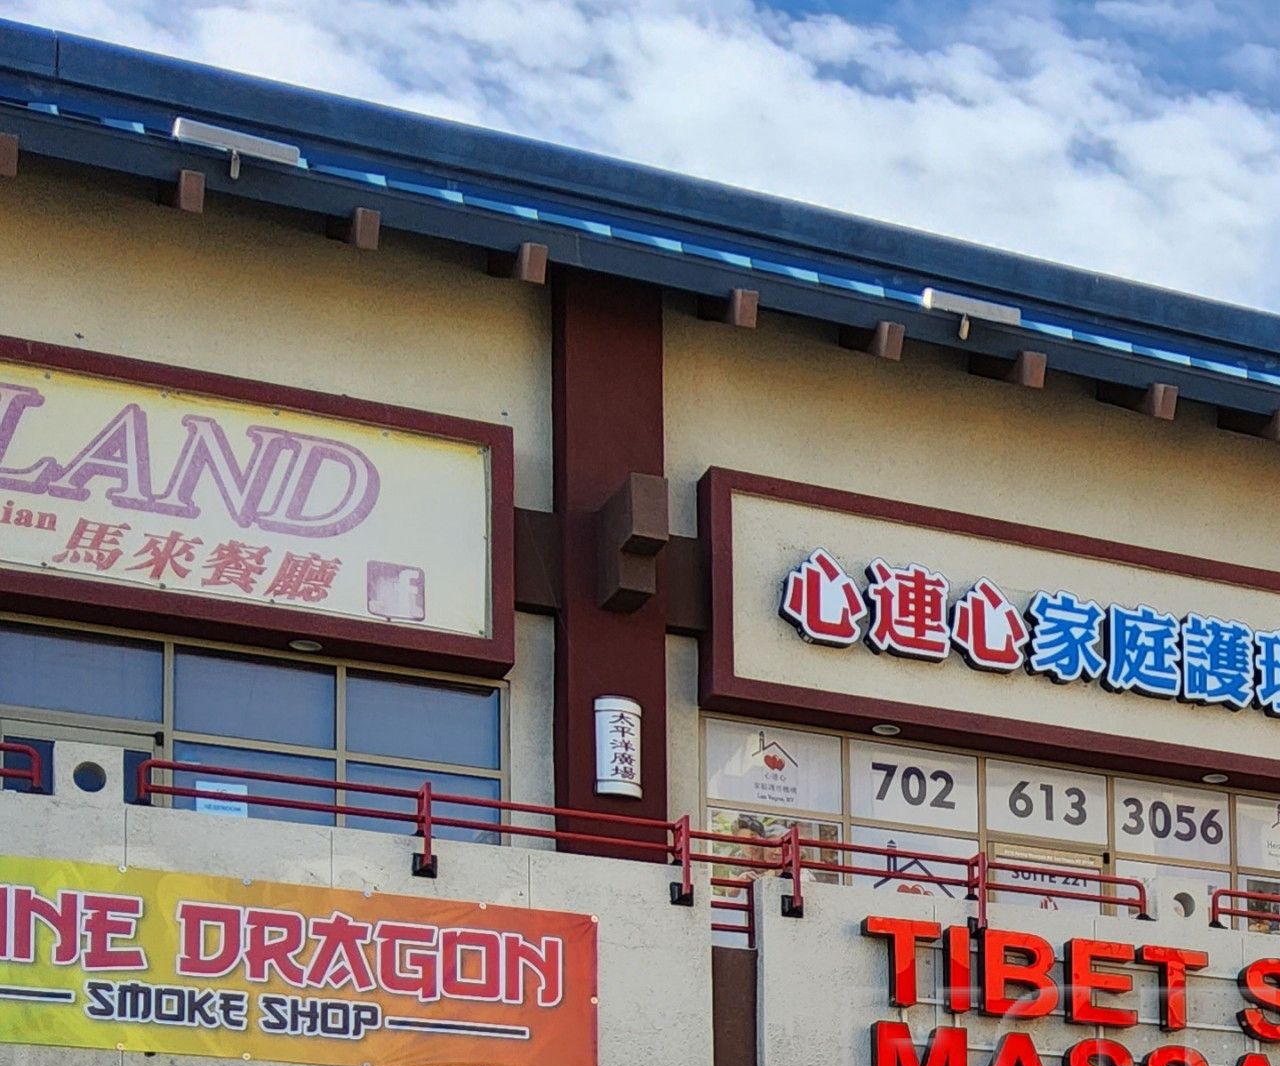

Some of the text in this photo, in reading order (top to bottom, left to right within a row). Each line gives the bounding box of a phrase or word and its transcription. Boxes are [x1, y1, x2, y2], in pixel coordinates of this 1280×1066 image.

[52, 516, 343, 602] 馬來餐廳
[609, 713, 636, 780] 太平洋廣場
[872, 762, 956, 810] 702
[1008, 781, 1087, 826] 613
[1121, 798, 1224, 845] 3056
[177, 901, 563, 1007] DRAGON
[861, 915, 1208, 1032] TIBET
[85, 980, 382, 1040] SMOKE SHOP
